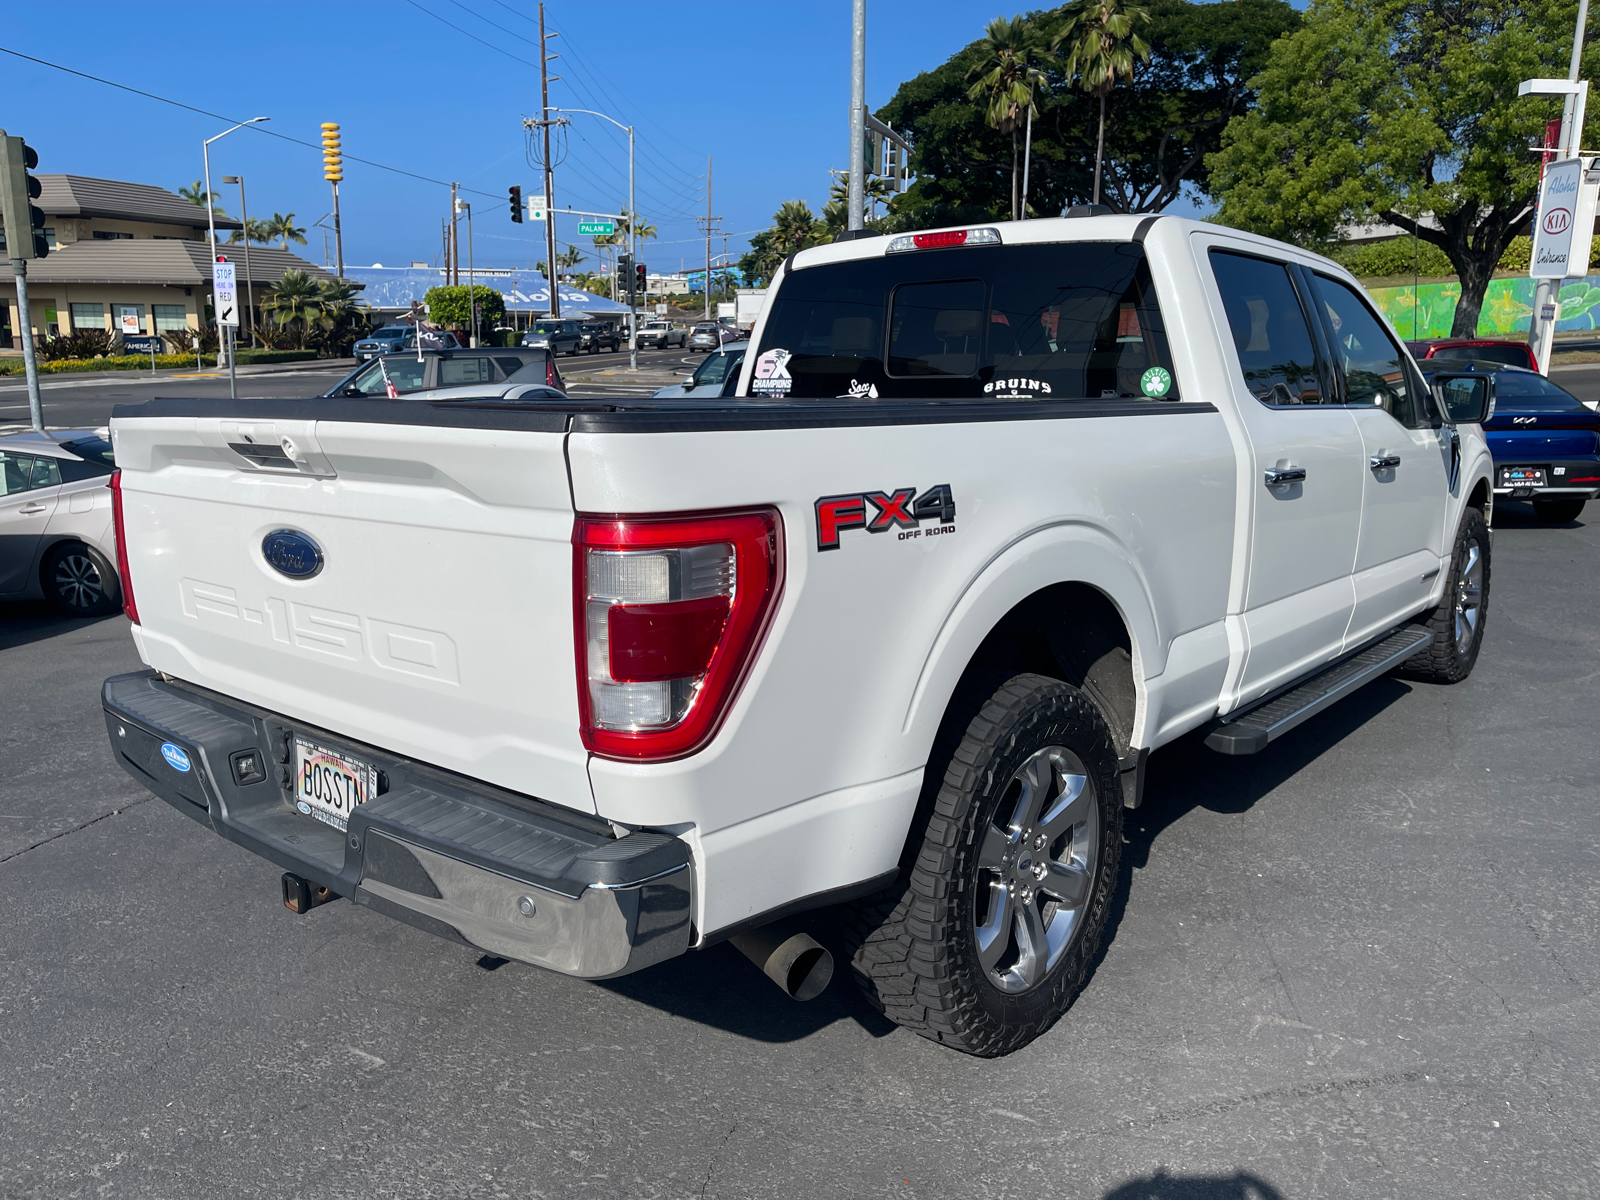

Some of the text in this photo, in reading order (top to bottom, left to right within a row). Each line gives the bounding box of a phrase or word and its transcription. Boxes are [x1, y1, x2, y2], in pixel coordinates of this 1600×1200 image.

[1547, 174, 1576, 195] Aloha
[1547, 214, 1566, 229] KIA
[1537, 247, 1567, 264] Entrance
[216, 269, 232, 279] STOP
[219, 292, 232, 302] RED
[1143, 368, 1170, 382] CELTICS
[752, 379, 793, 389] CHAMPIONS
[983, 378, 1052, 394] BRUINS
[814, 483, 956, 552] FX4
[898, 525, 956, 541] OFF ROAD
[270, 539, 304, 569] Ford
[178, 576, 461, 686] F-150
[320, 754, 345, 770] HAWAII
[303, 759, 363, 814] BOSSTN
